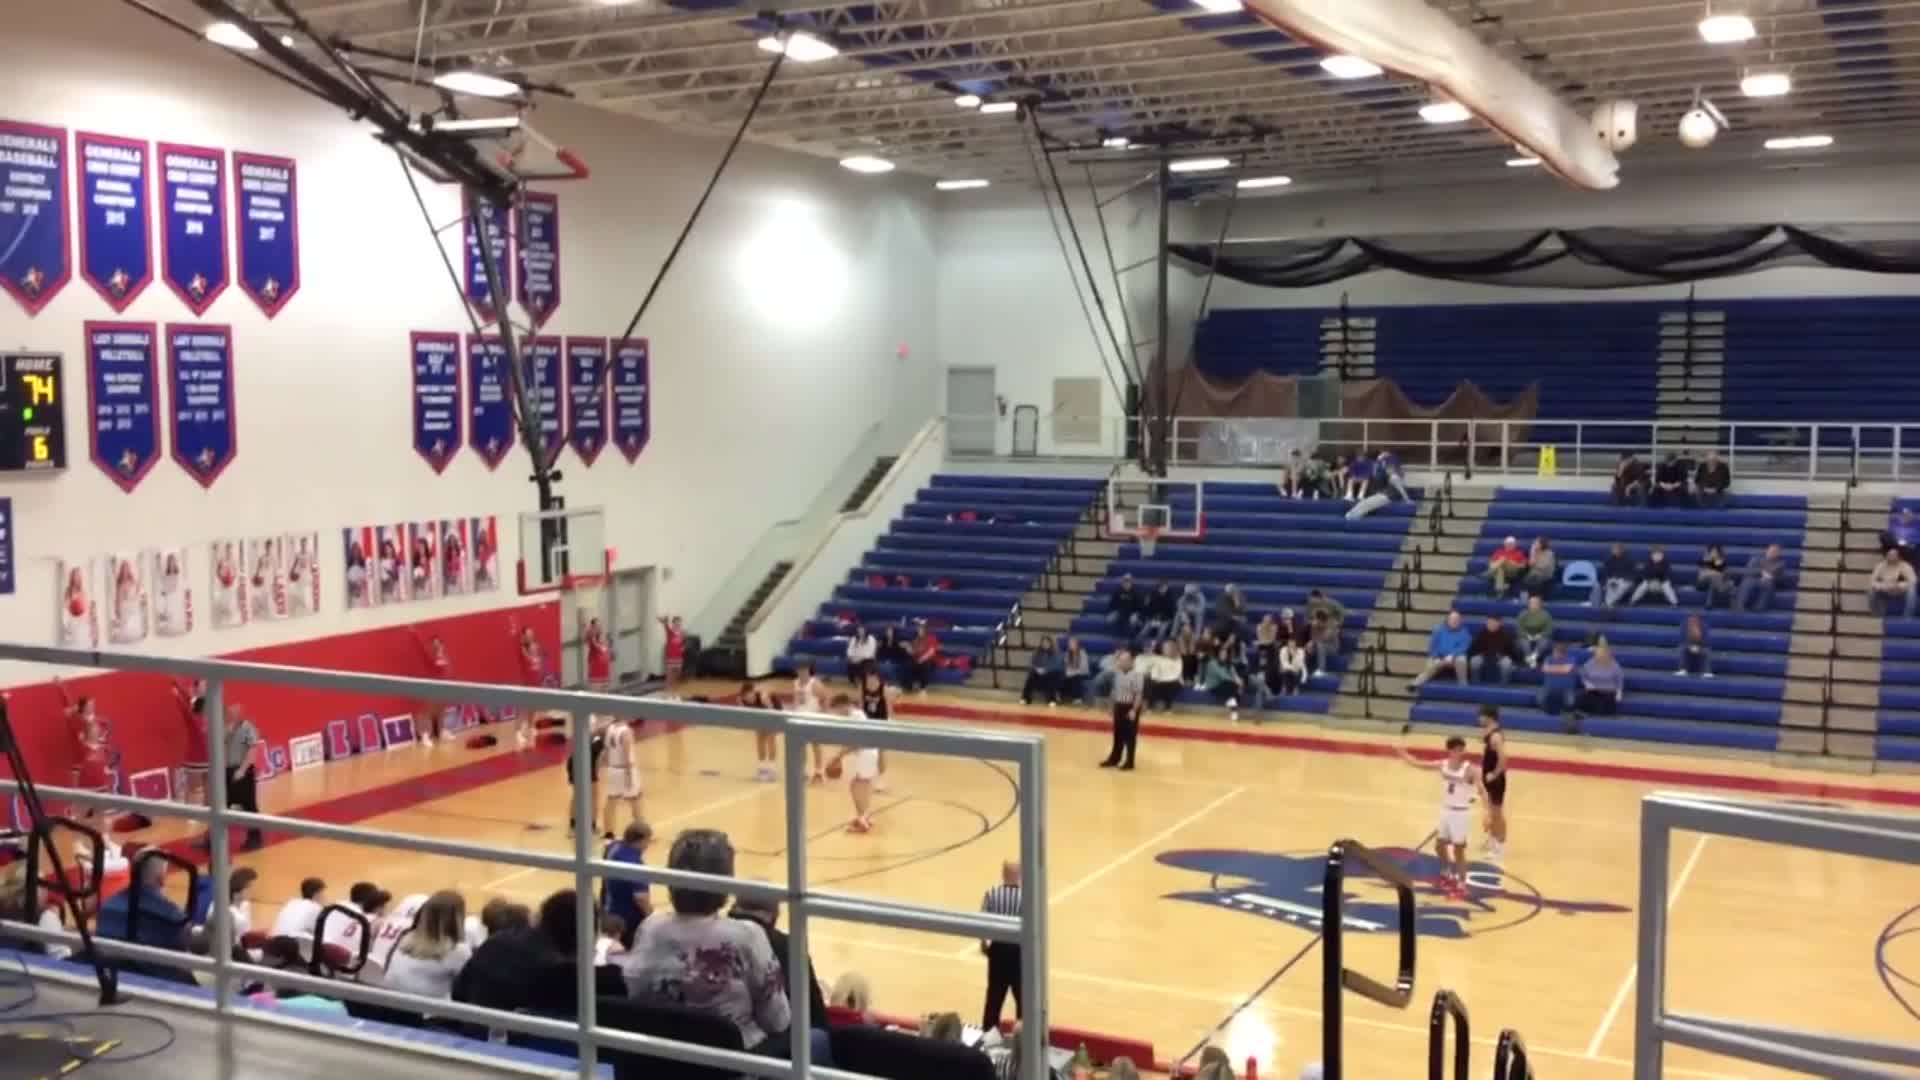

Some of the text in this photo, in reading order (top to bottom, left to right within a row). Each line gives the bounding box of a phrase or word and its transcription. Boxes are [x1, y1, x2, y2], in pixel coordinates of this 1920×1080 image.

[15, 359, 55, 371] HOME
[22, 375, 54, 405] 74
[34, 435, 48, 461] 6
